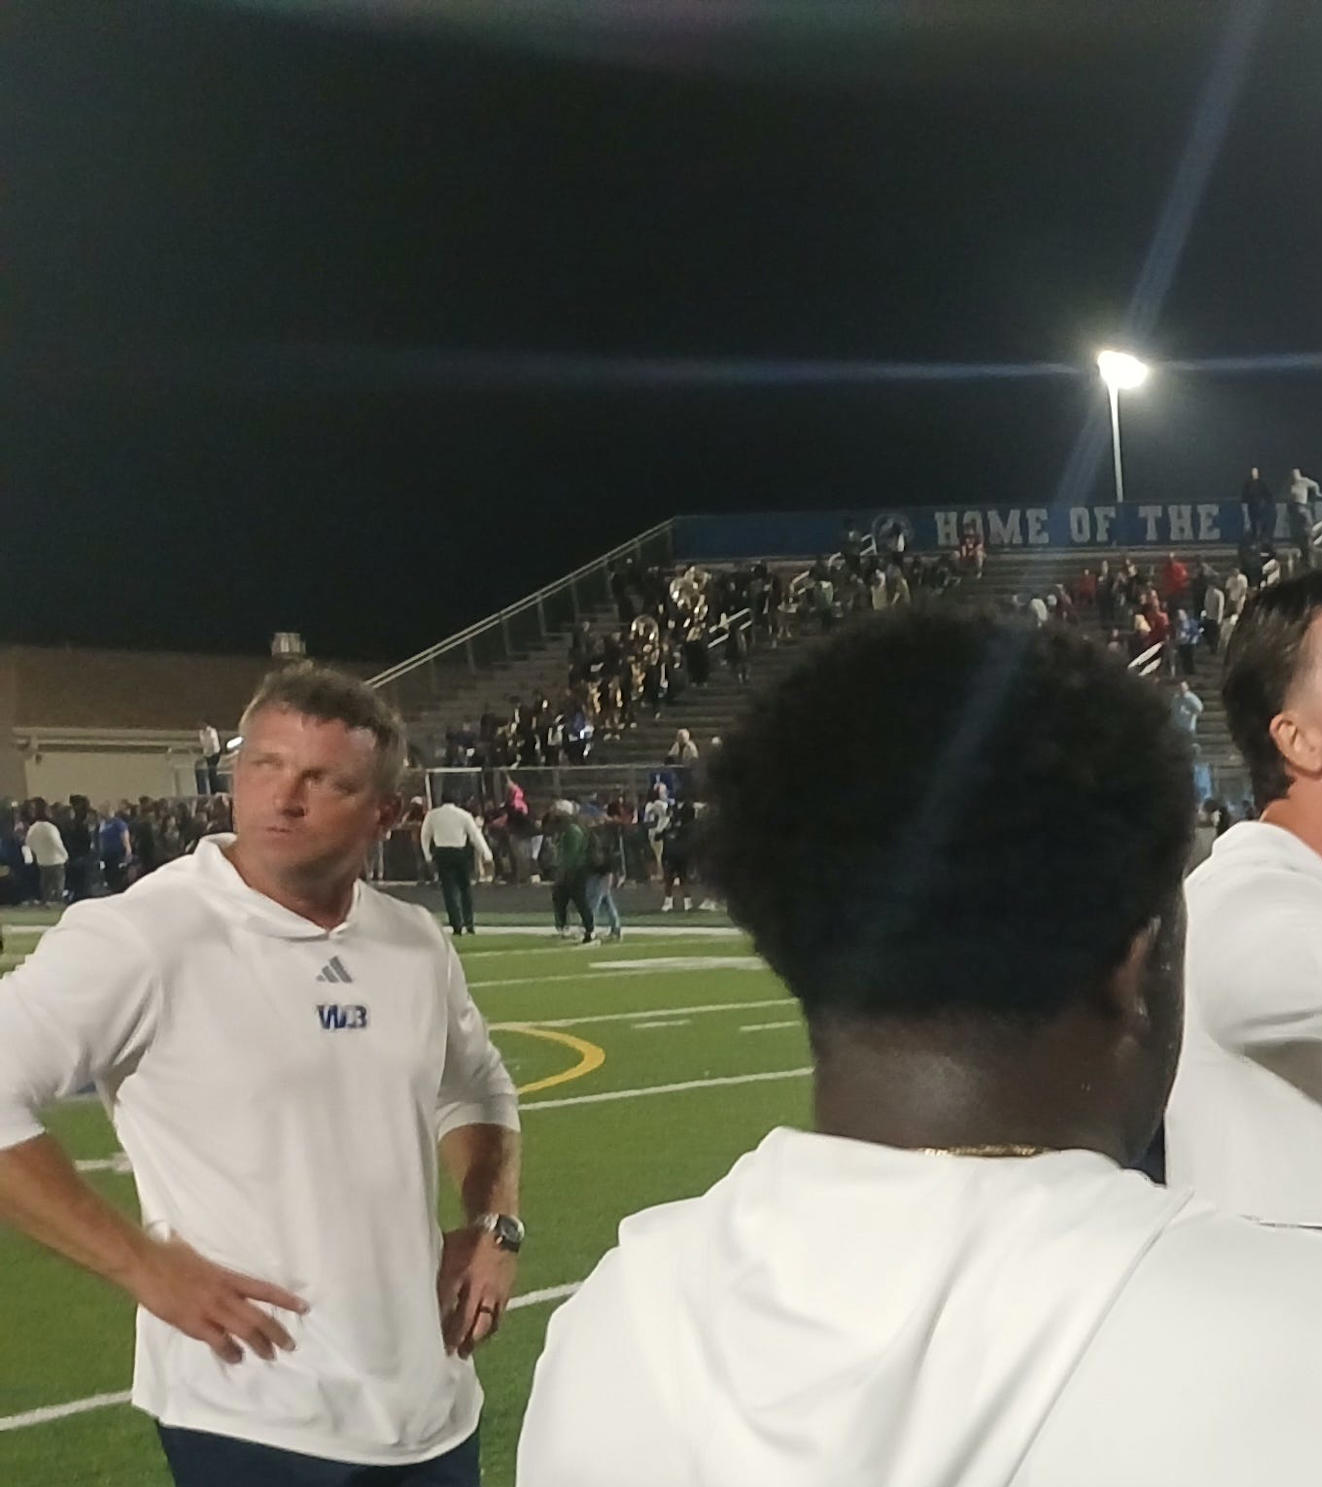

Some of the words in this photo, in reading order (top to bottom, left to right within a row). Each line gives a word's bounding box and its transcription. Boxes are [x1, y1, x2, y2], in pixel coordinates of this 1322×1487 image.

[934, 509, 1049, 546] HOME
[1070, 506, 1116, 542] OF
[1138, 504, 1221, 541] THE
[315, 1004, 368, 1030] WB
